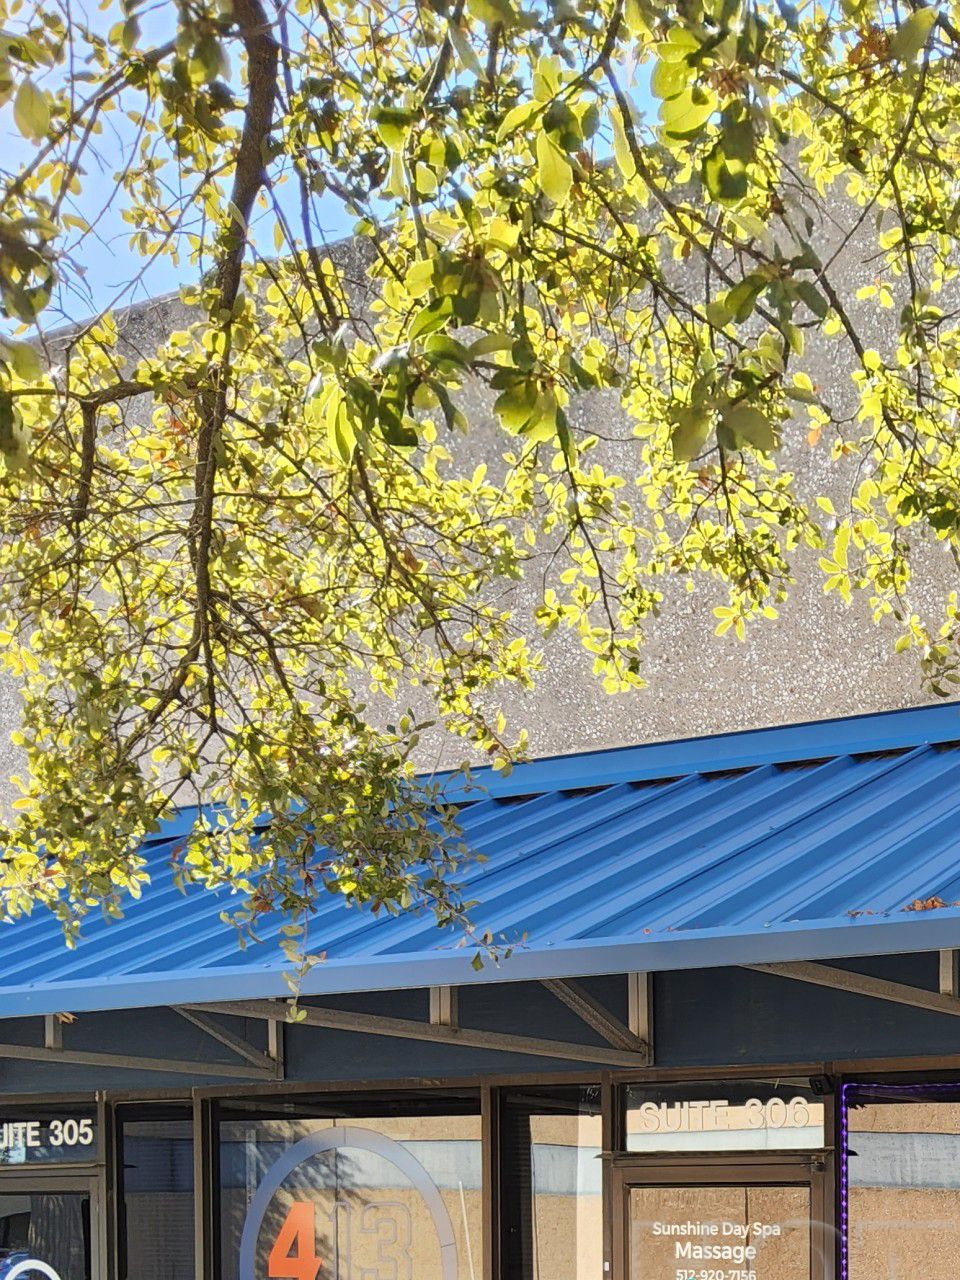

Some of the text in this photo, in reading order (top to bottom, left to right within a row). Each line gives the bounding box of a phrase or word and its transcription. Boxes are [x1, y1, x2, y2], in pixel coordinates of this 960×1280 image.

[639, 1096, 809, 1133] SUITE 306
[49, 1119, 94, 1146] 305
[652, 1222, 781, 1241] Sunshine Day Spa
[675, 1242, 757, 1264] Massage
